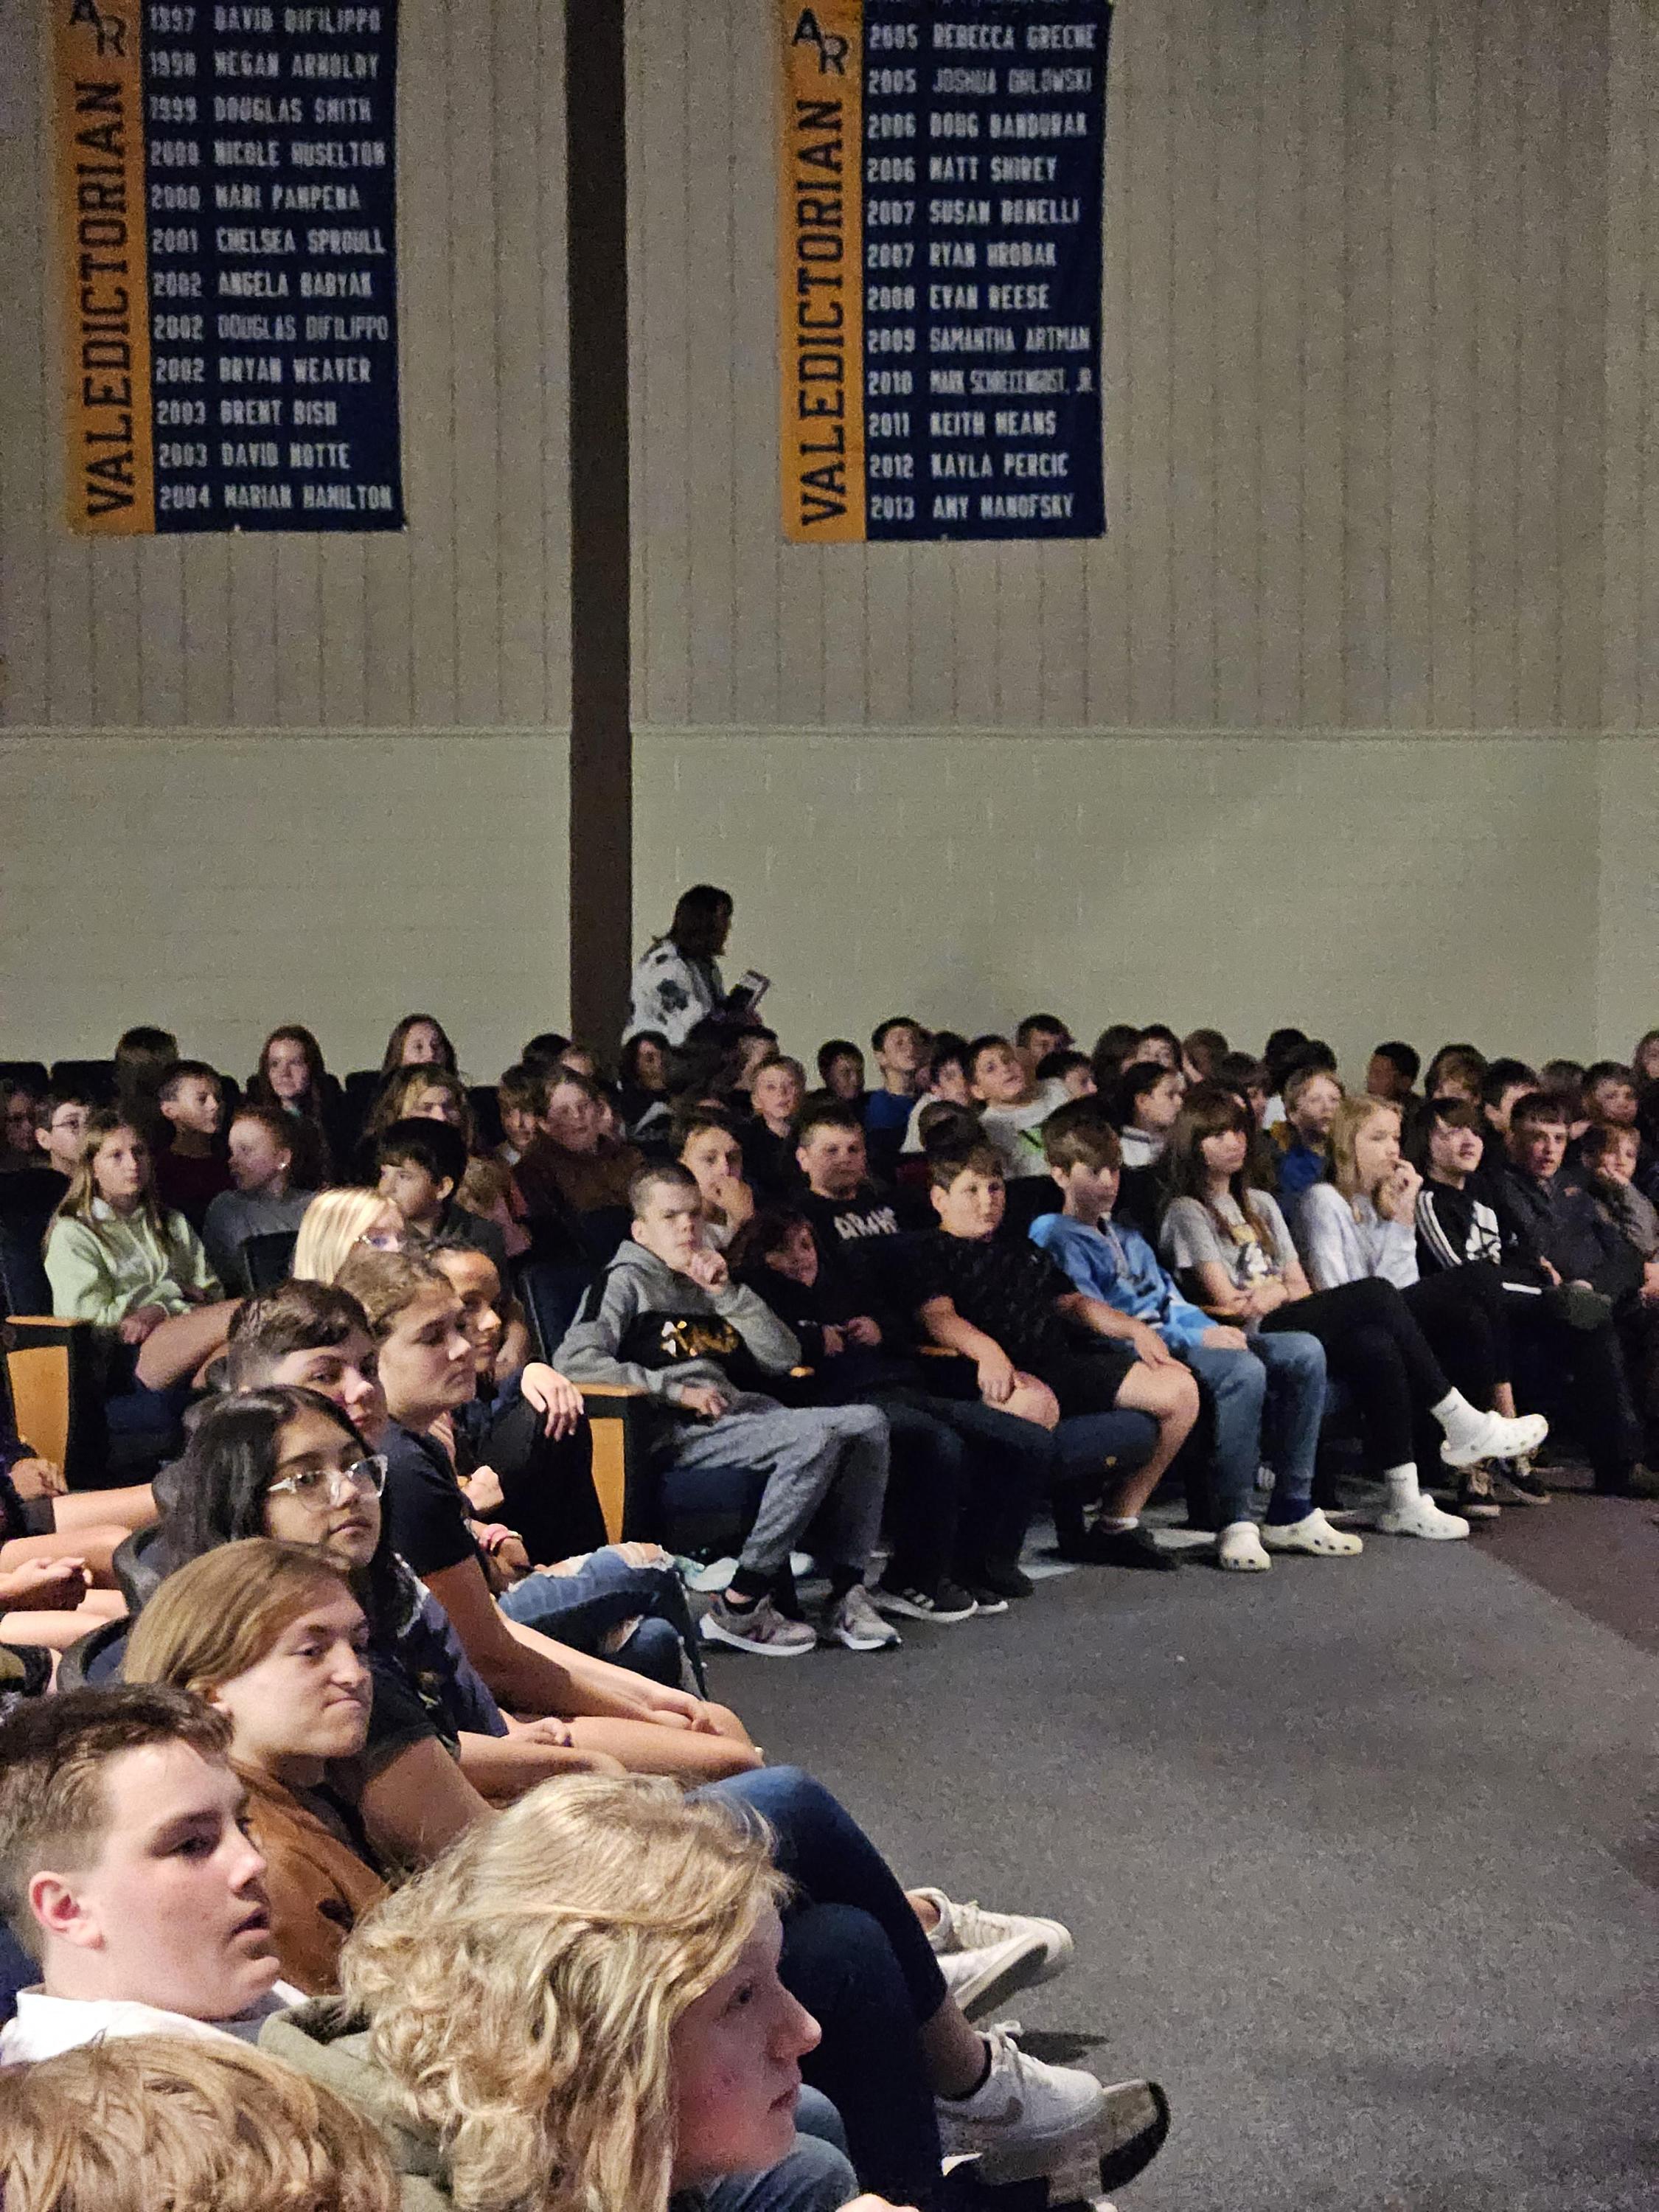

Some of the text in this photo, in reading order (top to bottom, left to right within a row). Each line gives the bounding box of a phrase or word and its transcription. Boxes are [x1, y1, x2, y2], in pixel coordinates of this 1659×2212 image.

[214, 6, 274, 32] DAVID
[869, 24, 918, 49] 2005
[933, 23, 1015, 49] REBECCA
[215, 51, 279, 77] MEGAN
[868, 69, 917, 94] 2005
[149, 96, 372, 123] 1999 DOUGLAS SMITH
[867, 113, 917, 139] 2006
[930, 112, 979, 138] DOUG
[150, 140, 200, 167] 2000
[214, 140, 279, 167] NICOLE
[866, 156, 916, 182] 2006
[929, 156, 978, 181] MATT
[151, 184, 201, 210] 2000
[867, 199, 915, 226] 2007
[929, 198, 990, 225] SUSAN
[153, 228, 198, 254] 2001
[216, 227, 296, 254] CHELSEA
[867, 242, 915, 268] 2007
[929, 242, 977, 268] RYAN
[153, 271, 201, 297] 2002
[218, 271, 289, 298] ANGELA
[929, 284, 978, 310] EVAN
[987, 283, 1049, 310] REESE
[75, 81, 135, 516] VALEDICTORIAN
[796, 100, 847, 525] VALEDICTORIAN
[153, 314, 204, 341] 2002
[218, 313, 296, 341] DOUGLAS
[867, 326, 1091, 353] 2009 SAMANTHA ARTMAN
[156, 356, 371, 383] 2002 BRYAN WEAVER
[867, 369, 913, 396] 2010
[929, 368, 964, 394] MARK
[157, 399, 338, 426] 2003 BRENT BISH
[868, 409, 1057, 438] 2011 KEITH MEANS
[159, 442, 208, 468] 2003
[221, 442, 279, 467] DAVID
[869, 452, 1069, 479] 2012 KAYLA PERCIC
[159, 484, 392, 510] 2004 MARIAN HAMILTON
[870, 495, 915, 521] 2013
[932, 495, 969, 520] AMY
